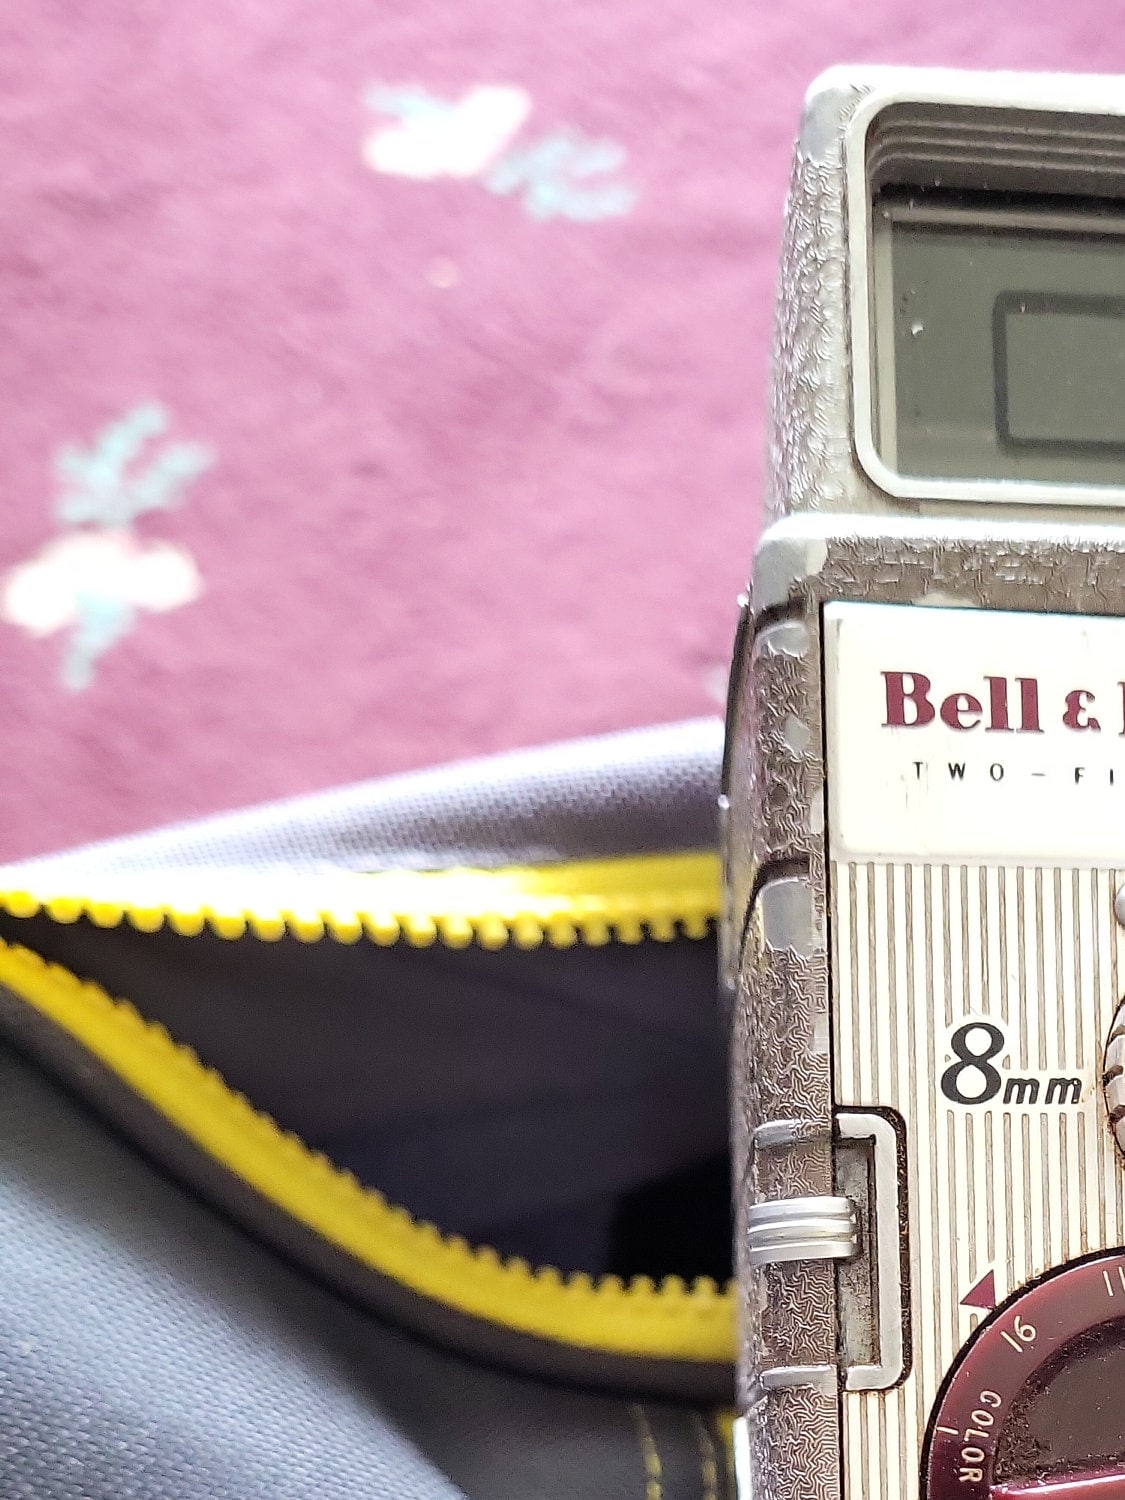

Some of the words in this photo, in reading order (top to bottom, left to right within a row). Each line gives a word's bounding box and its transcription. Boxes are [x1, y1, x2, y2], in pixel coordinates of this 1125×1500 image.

[880, 670, 1045, 733] Bell
[1062, 689, 1102, 731] &
[940, 1022, 1082, 1105] 8mm
[1000, 1316, 1036, 1353] 16
[959, 1389, 1002, 1483] COLOR
